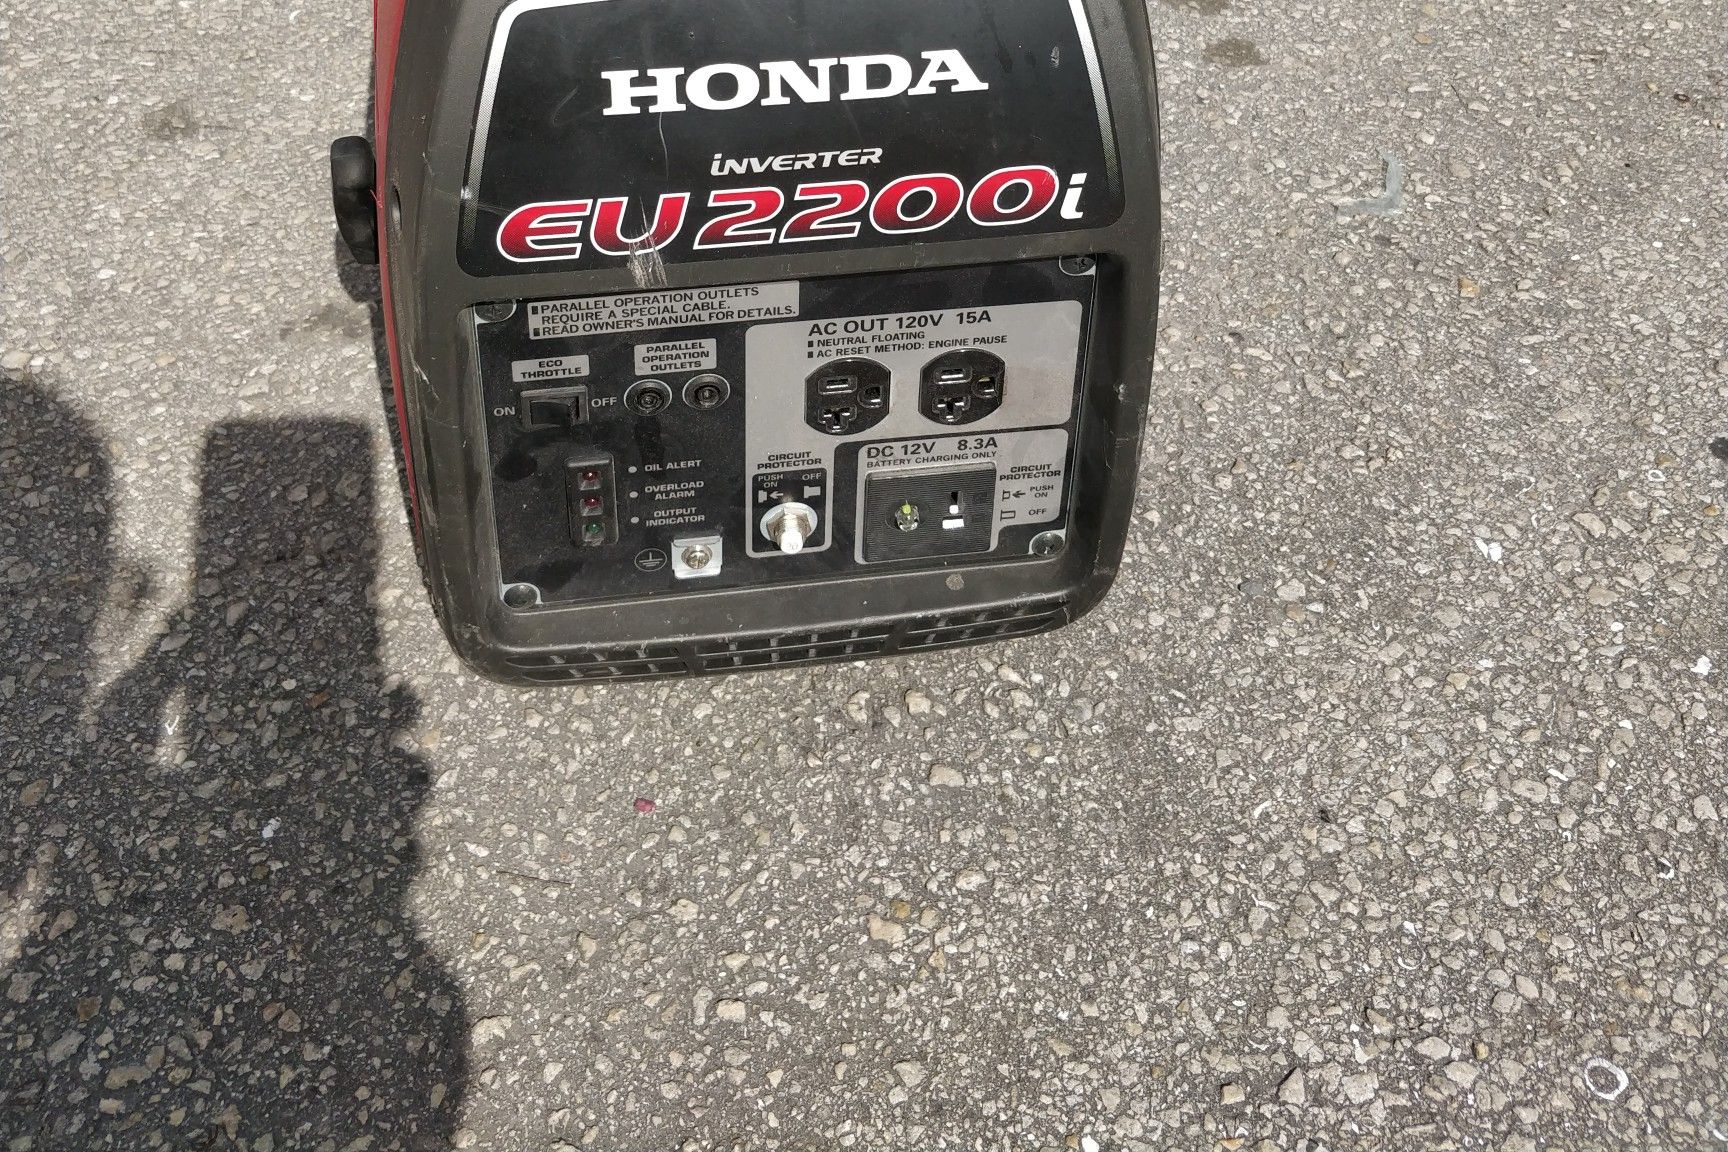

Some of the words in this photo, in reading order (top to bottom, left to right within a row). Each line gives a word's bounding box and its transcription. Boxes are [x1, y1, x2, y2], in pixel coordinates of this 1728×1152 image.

[601, 49, 988, 116] HONDA
[711, 147, 882, 175] iNVERTER
[496, 165, 1085, 262] EU2200i
[541, 299, 609, 314] PARALLEL
[614, 294, 694, 308] OPERATION
[698, 287, 759, 300] OUTLETS
[542, 311, 602, 325] REQUIRE
[608, 309, 617, 319] A
[622, 305, 679, 318] SPECIAL
[683, 301, 730, 312] CABLE.
[543, 325, 579, 335] READ
[582, 319, 644, 332] OWNER'S
[647, 313, 705, 326] MANUAL
[709, 310, 734, 321] FOR
[737, 305, 796, 318] DETAILS.
[809, 322, 838, 336] AC
[844, 317, 889, 333] OUT
[896, 314, 943, 329] 120V
[956, 310, 992, 325] 15A
[817, 335, 868, 347] NEUTRAL
[871, 331, 925, 343] FLOATING
[646, 342, 705, 353] PARALLEL
[817, 349, 832, 358] AC
[836, 345, 871, 356] RESET
[874, 341, 924, 353] METHOD:
[928, 338, 969, 349] ENGINE
[973, 335, 1007, 345] PAUSE
[642, 350, 709, 362] OPERATION
[538, 360, 563, 368] ECO
[650, 361, 701, 371] OUTLETS
[520, 367, 582, 379] THROTTLE
[591, 396, 617, 408] OFF
[494, 406, 515, 417] ON
[867, 444, 894, 459] DC
[900, 442, 936, 457] 12V
[957, 437, 998, 451] 8.3A
[768, 451, 812, 462] CIRCUIT
[867, 458, 912, 468] BATTERY
[915, 454, 969, 464] CHARGING
[972, 450, 997, 460] ONLY
[644, 463, 664, 472] OIL
[666, 460, 701, 470] ALERT
[757, 458, 822, 470] PROTECTOR
[1010, 464, 1052, 473] CIRCUIT
[758, 473, 784, 481] PUSH
[802, 473, 822, 481] OFF
[999, 469, 1061, 481] PROTECTOR
[645, 480, 704, 493] OVERLOAD
[763, 480, 778, 489] ON
[1030, 484, 1054, 493] PUSH
[654, 490, 695, 500] ALARM
[1034, 490, 1048, 499] ON
[653, 507, 697, 518] OUTPUT
[1028, 508, 1047, 516] OFF
[645, 514, 705, 527] INDICATOR
